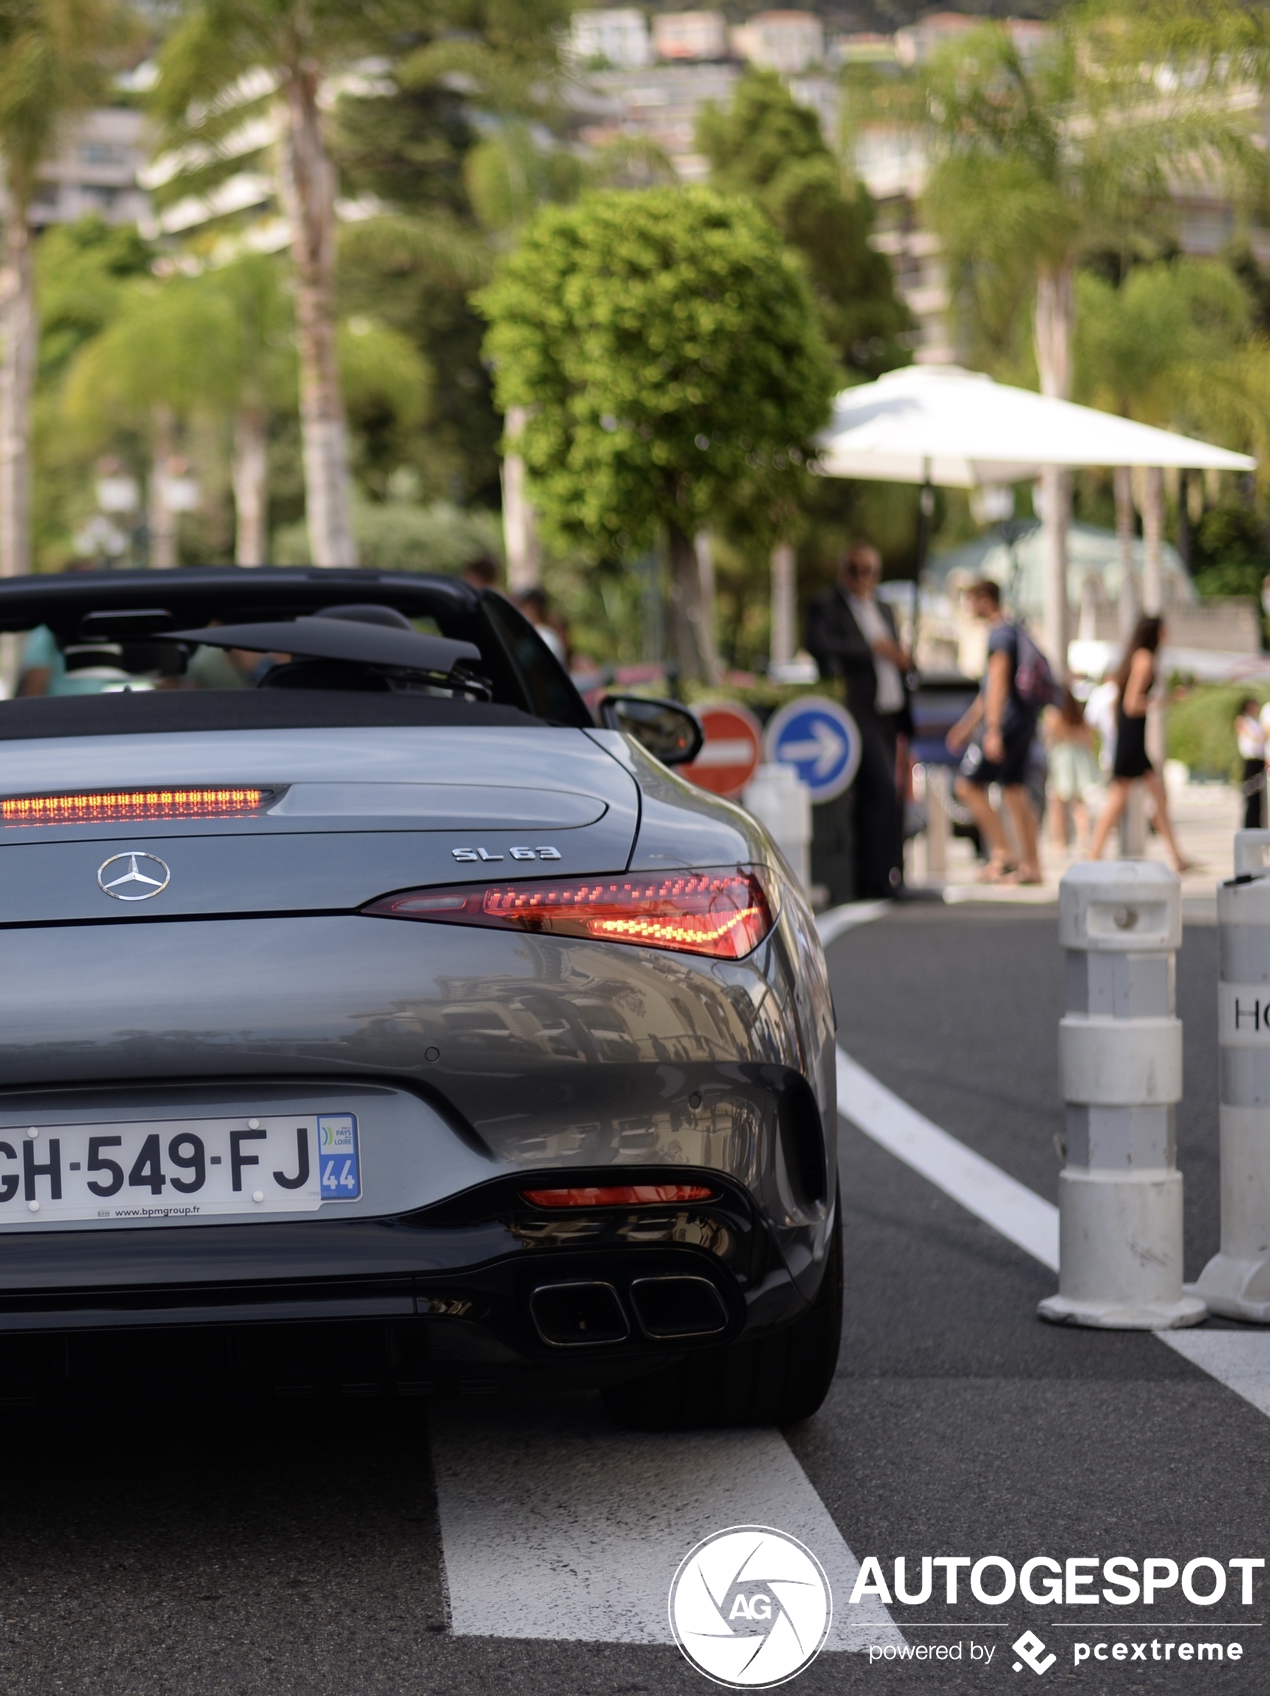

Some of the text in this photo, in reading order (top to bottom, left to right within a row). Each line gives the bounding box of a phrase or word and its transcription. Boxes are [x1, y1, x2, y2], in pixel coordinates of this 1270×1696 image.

[451, 846, 562, 862] SL 63
[1235, 996, 1270, 1032] H
[322, 1160, 356, 1190] 44
[115, 1206, 201, 1217] www.bpmgroup.fr
